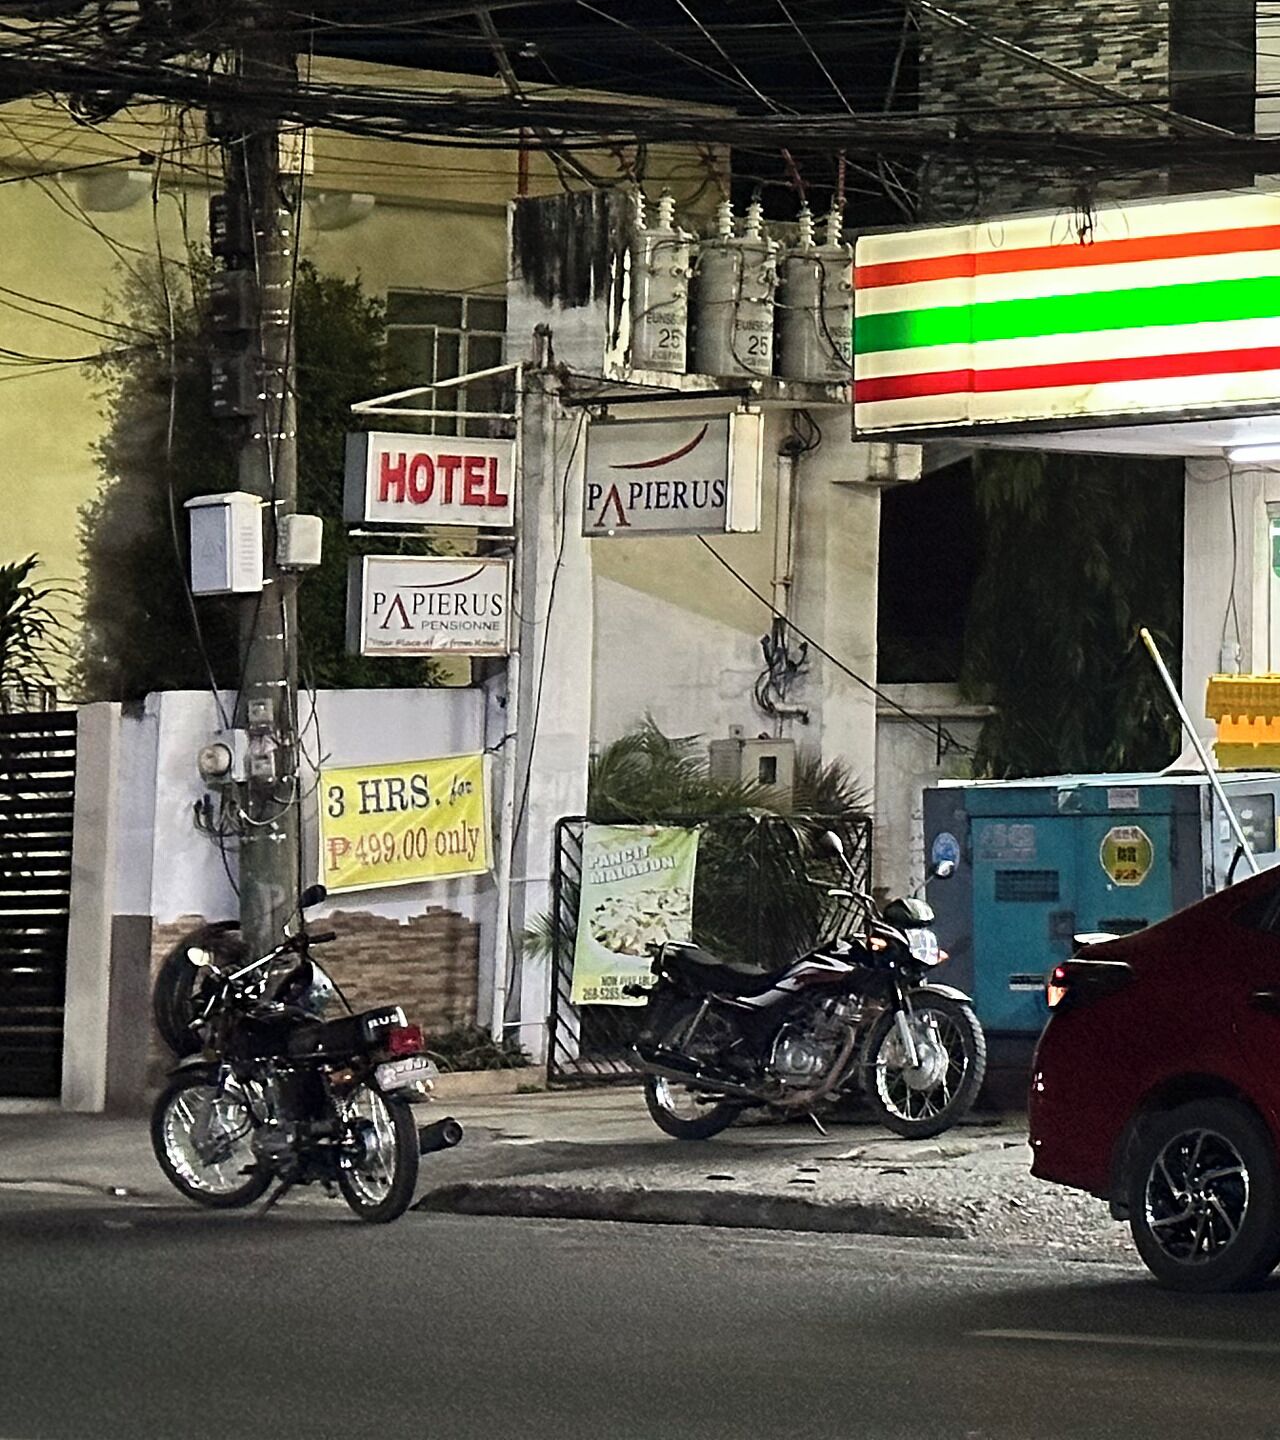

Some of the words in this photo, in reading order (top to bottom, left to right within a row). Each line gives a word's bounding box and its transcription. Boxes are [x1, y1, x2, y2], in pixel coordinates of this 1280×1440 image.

[377, 451, 509, 508] HOTEL
[586, 479, 726, 528] PAPIERUS
[373, 591, 503, 631] PAPIERUS
[421, 619, 500, 632] PENSIONNE
[327, 785, 346, 818] 3
[356, 773, 441, 815] HRS.
[435, 819, 480, 863] only
[587, 844, 652, 870] PANCIT
